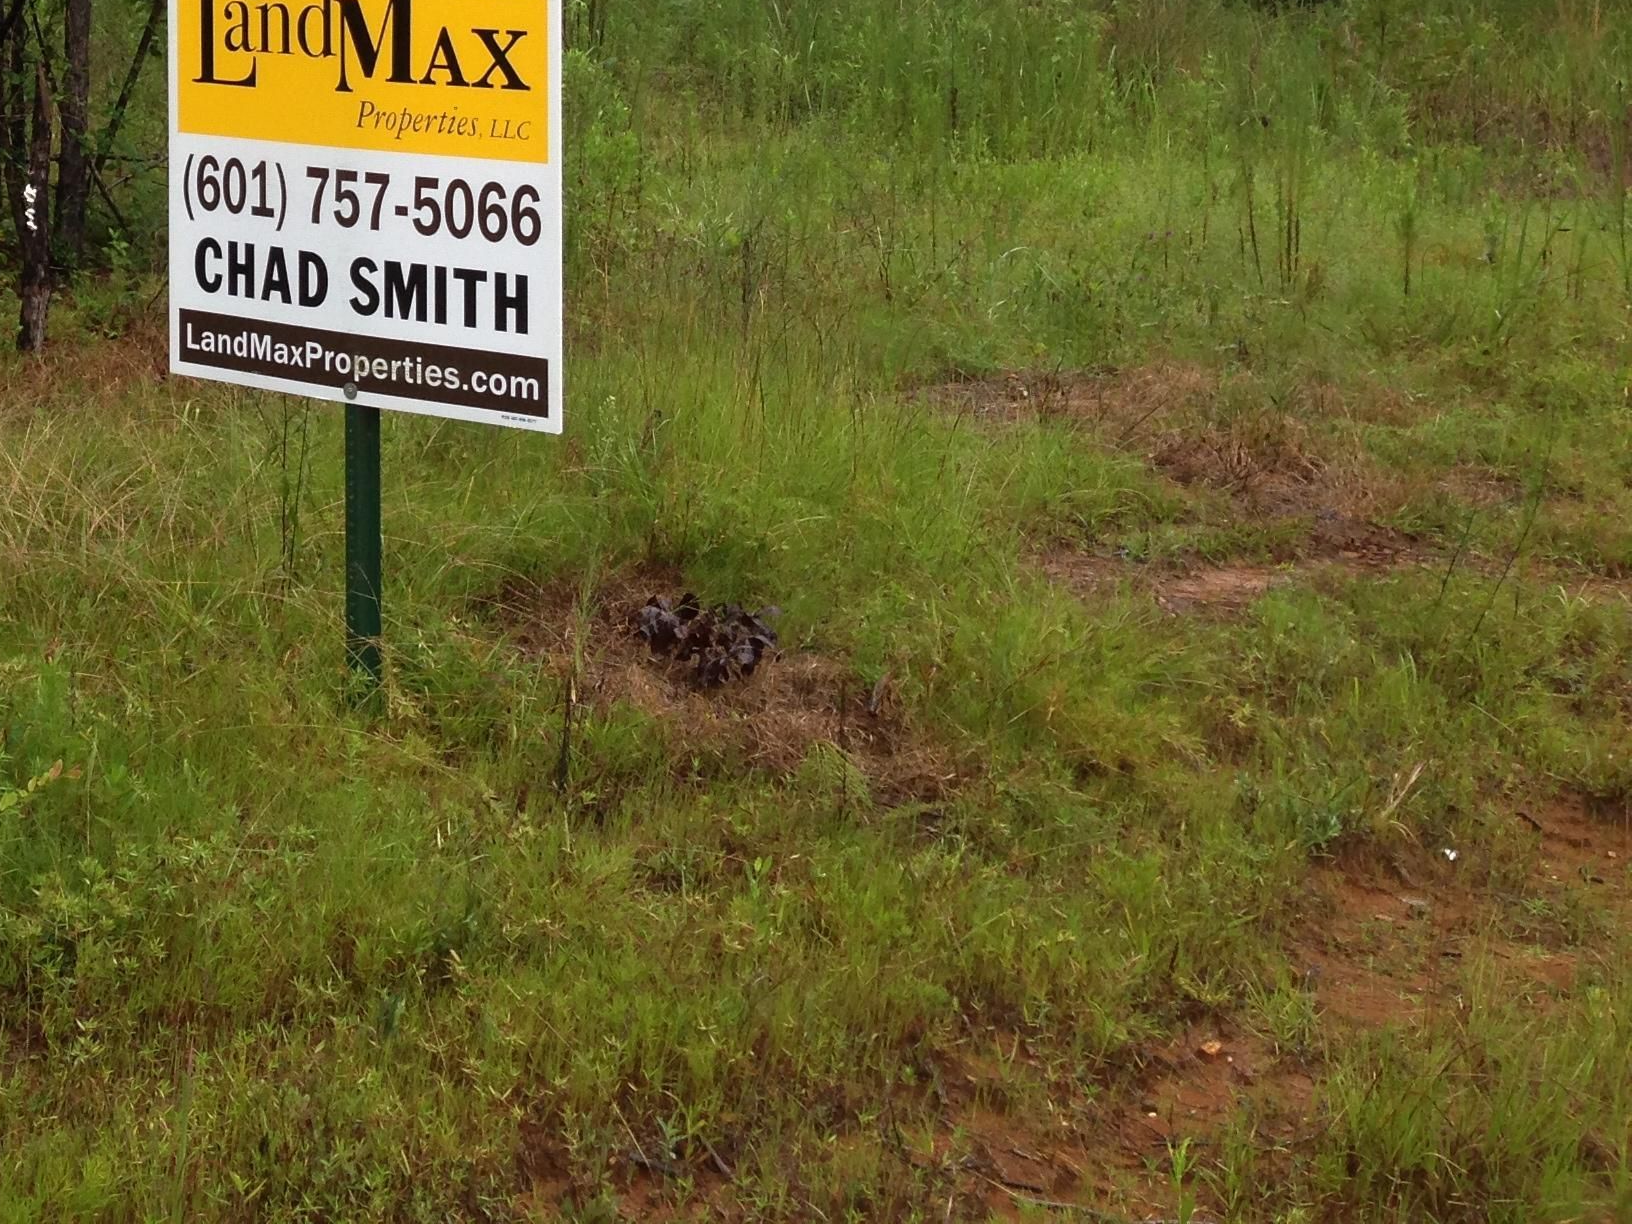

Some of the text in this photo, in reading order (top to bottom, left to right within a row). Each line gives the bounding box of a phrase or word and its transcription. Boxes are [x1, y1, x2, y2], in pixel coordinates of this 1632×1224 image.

[356, 100, 531, 141] Properties, LLC
[183, 153, 542, 247] (601) 757-5066
[194, 237, 529, 335] CHAD SMITH
[186, 322, 539, 401] LandMaxProperties.com
